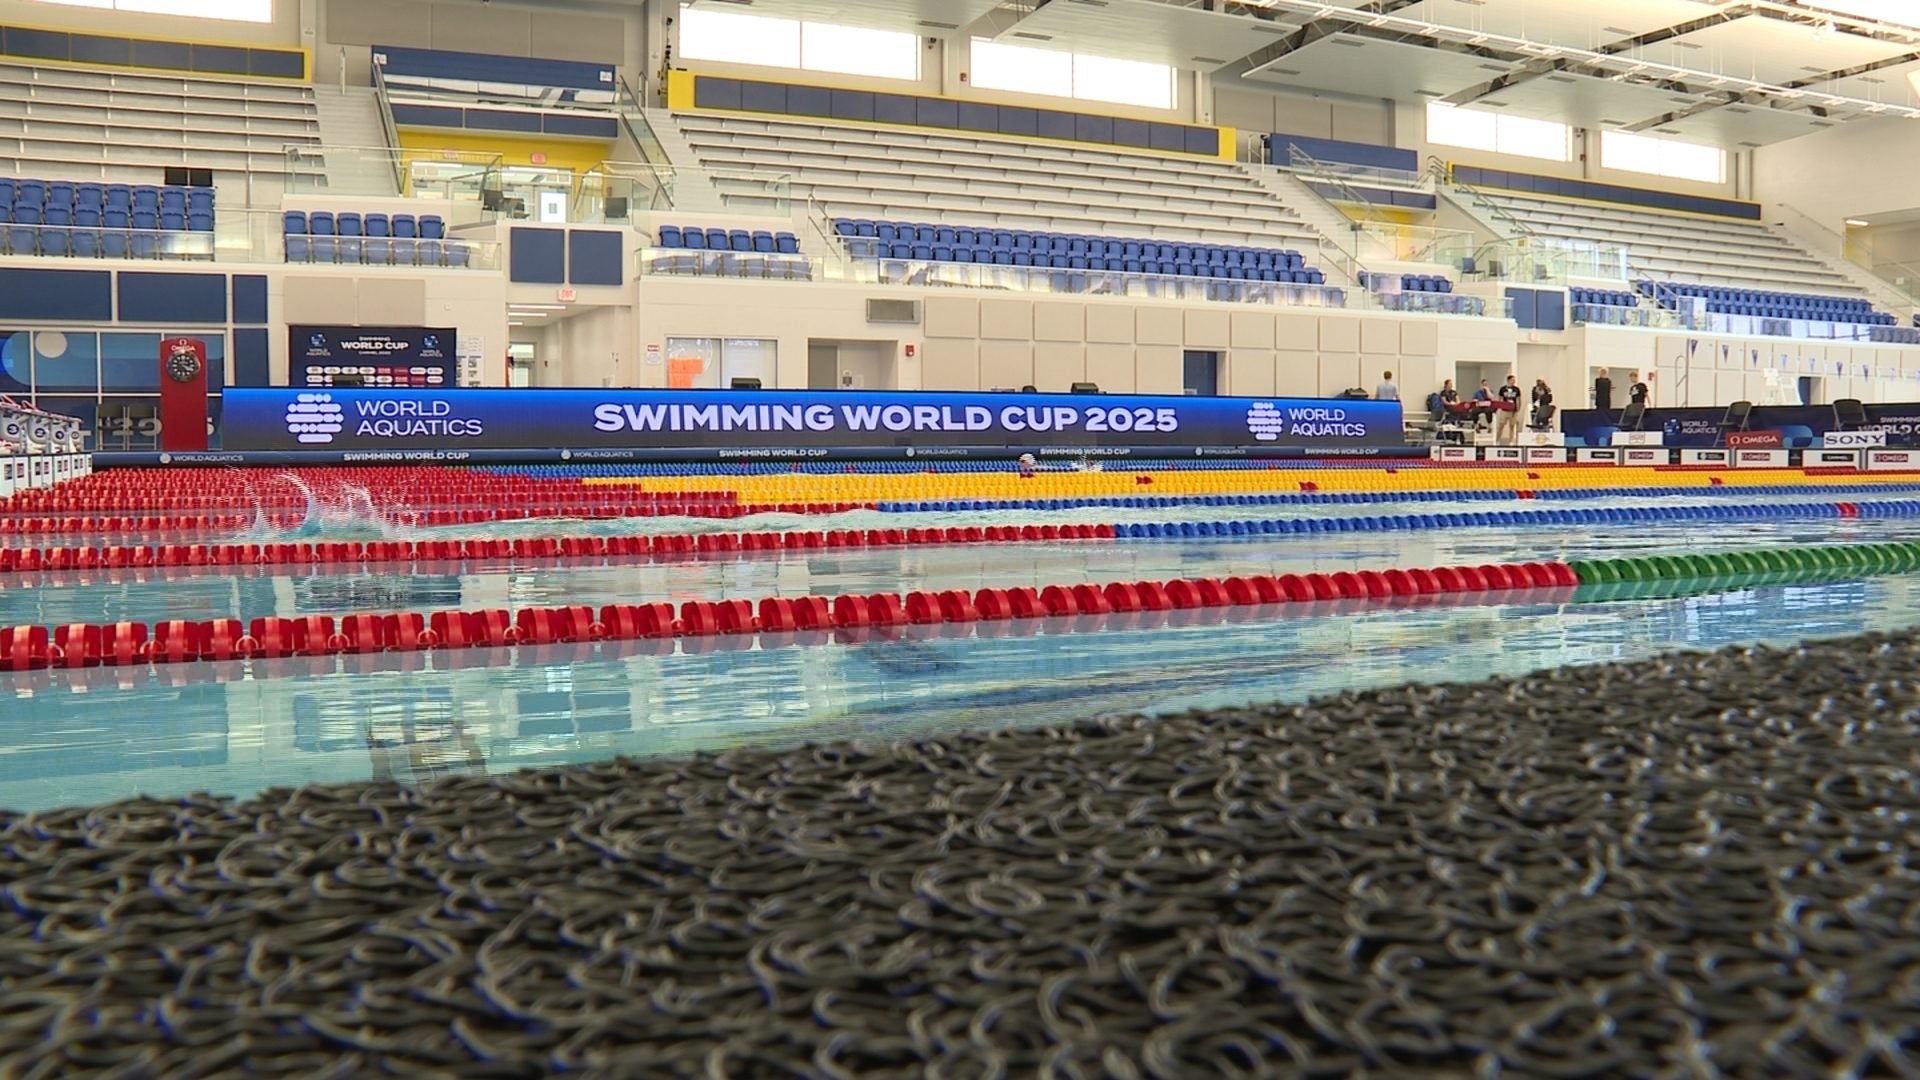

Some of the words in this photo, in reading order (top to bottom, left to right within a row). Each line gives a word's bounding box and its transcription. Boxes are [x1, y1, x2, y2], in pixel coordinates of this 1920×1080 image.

[356, 400, 450, 416] WORLD
[1288, 408, 1345, 421] WORLD
[594, 404, 835, 431] SWIMMING
[841, 405, 992, 431] WORLD
[1000, 406, 1078, 431] CUP
[1084, 408, 1178, 432] 2025
[356, 419, 483, 437] AQUATICS
[1289, 423, 1366, 437] AQUATICS
[1742, 435, 1778, 444] OMEGA
[1825, 435, 1884, 445] SONY
